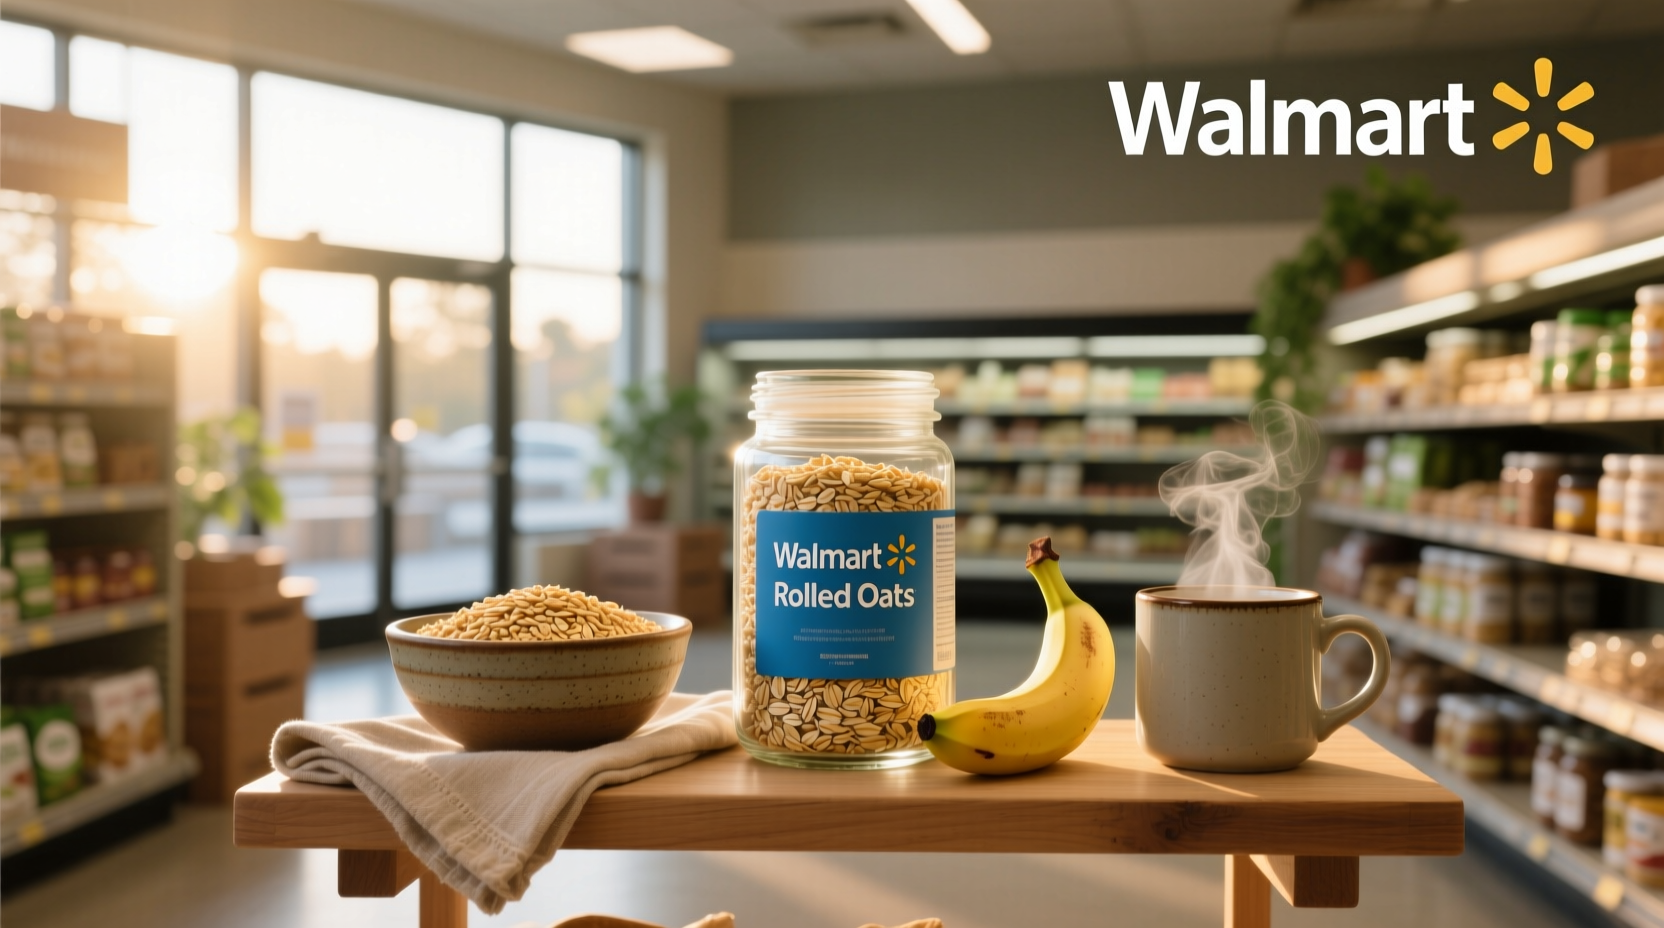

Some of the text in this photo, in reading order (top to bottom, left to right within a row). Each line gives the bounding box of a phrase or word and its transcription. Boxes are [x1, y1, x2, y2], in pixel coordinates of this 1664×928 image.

[773, 541, 882, 570] Walmart
[774, 581, 915, 609] Rolled Oats
